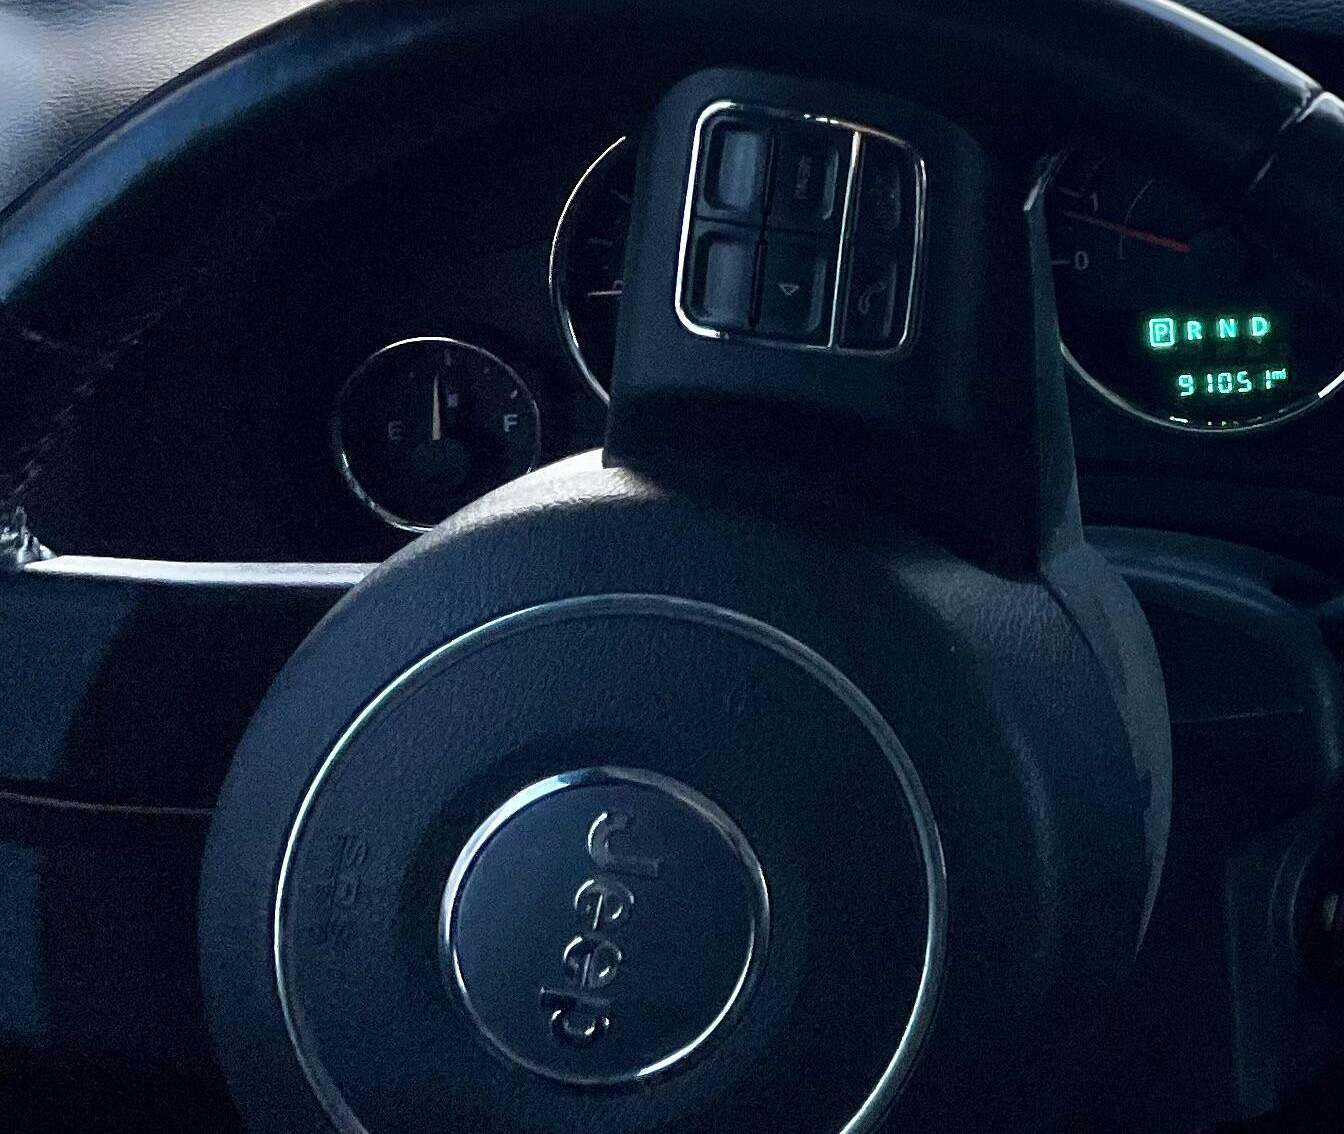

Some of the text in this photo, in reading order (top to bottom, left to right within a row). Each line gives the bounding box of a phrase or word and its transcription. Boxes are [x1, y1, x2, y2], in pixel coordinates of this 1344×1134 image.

[1073, 250, 1090, 271] 0
[1186, 320, 1203, 341] R
[1218, 318, 1239, 339] N
[1250, 316, 1271, 337] D
[1178, 370, 1272, 397] 91051
[503, 413, 519, 433] F
[538, 810, 666, 1047] Jeep
